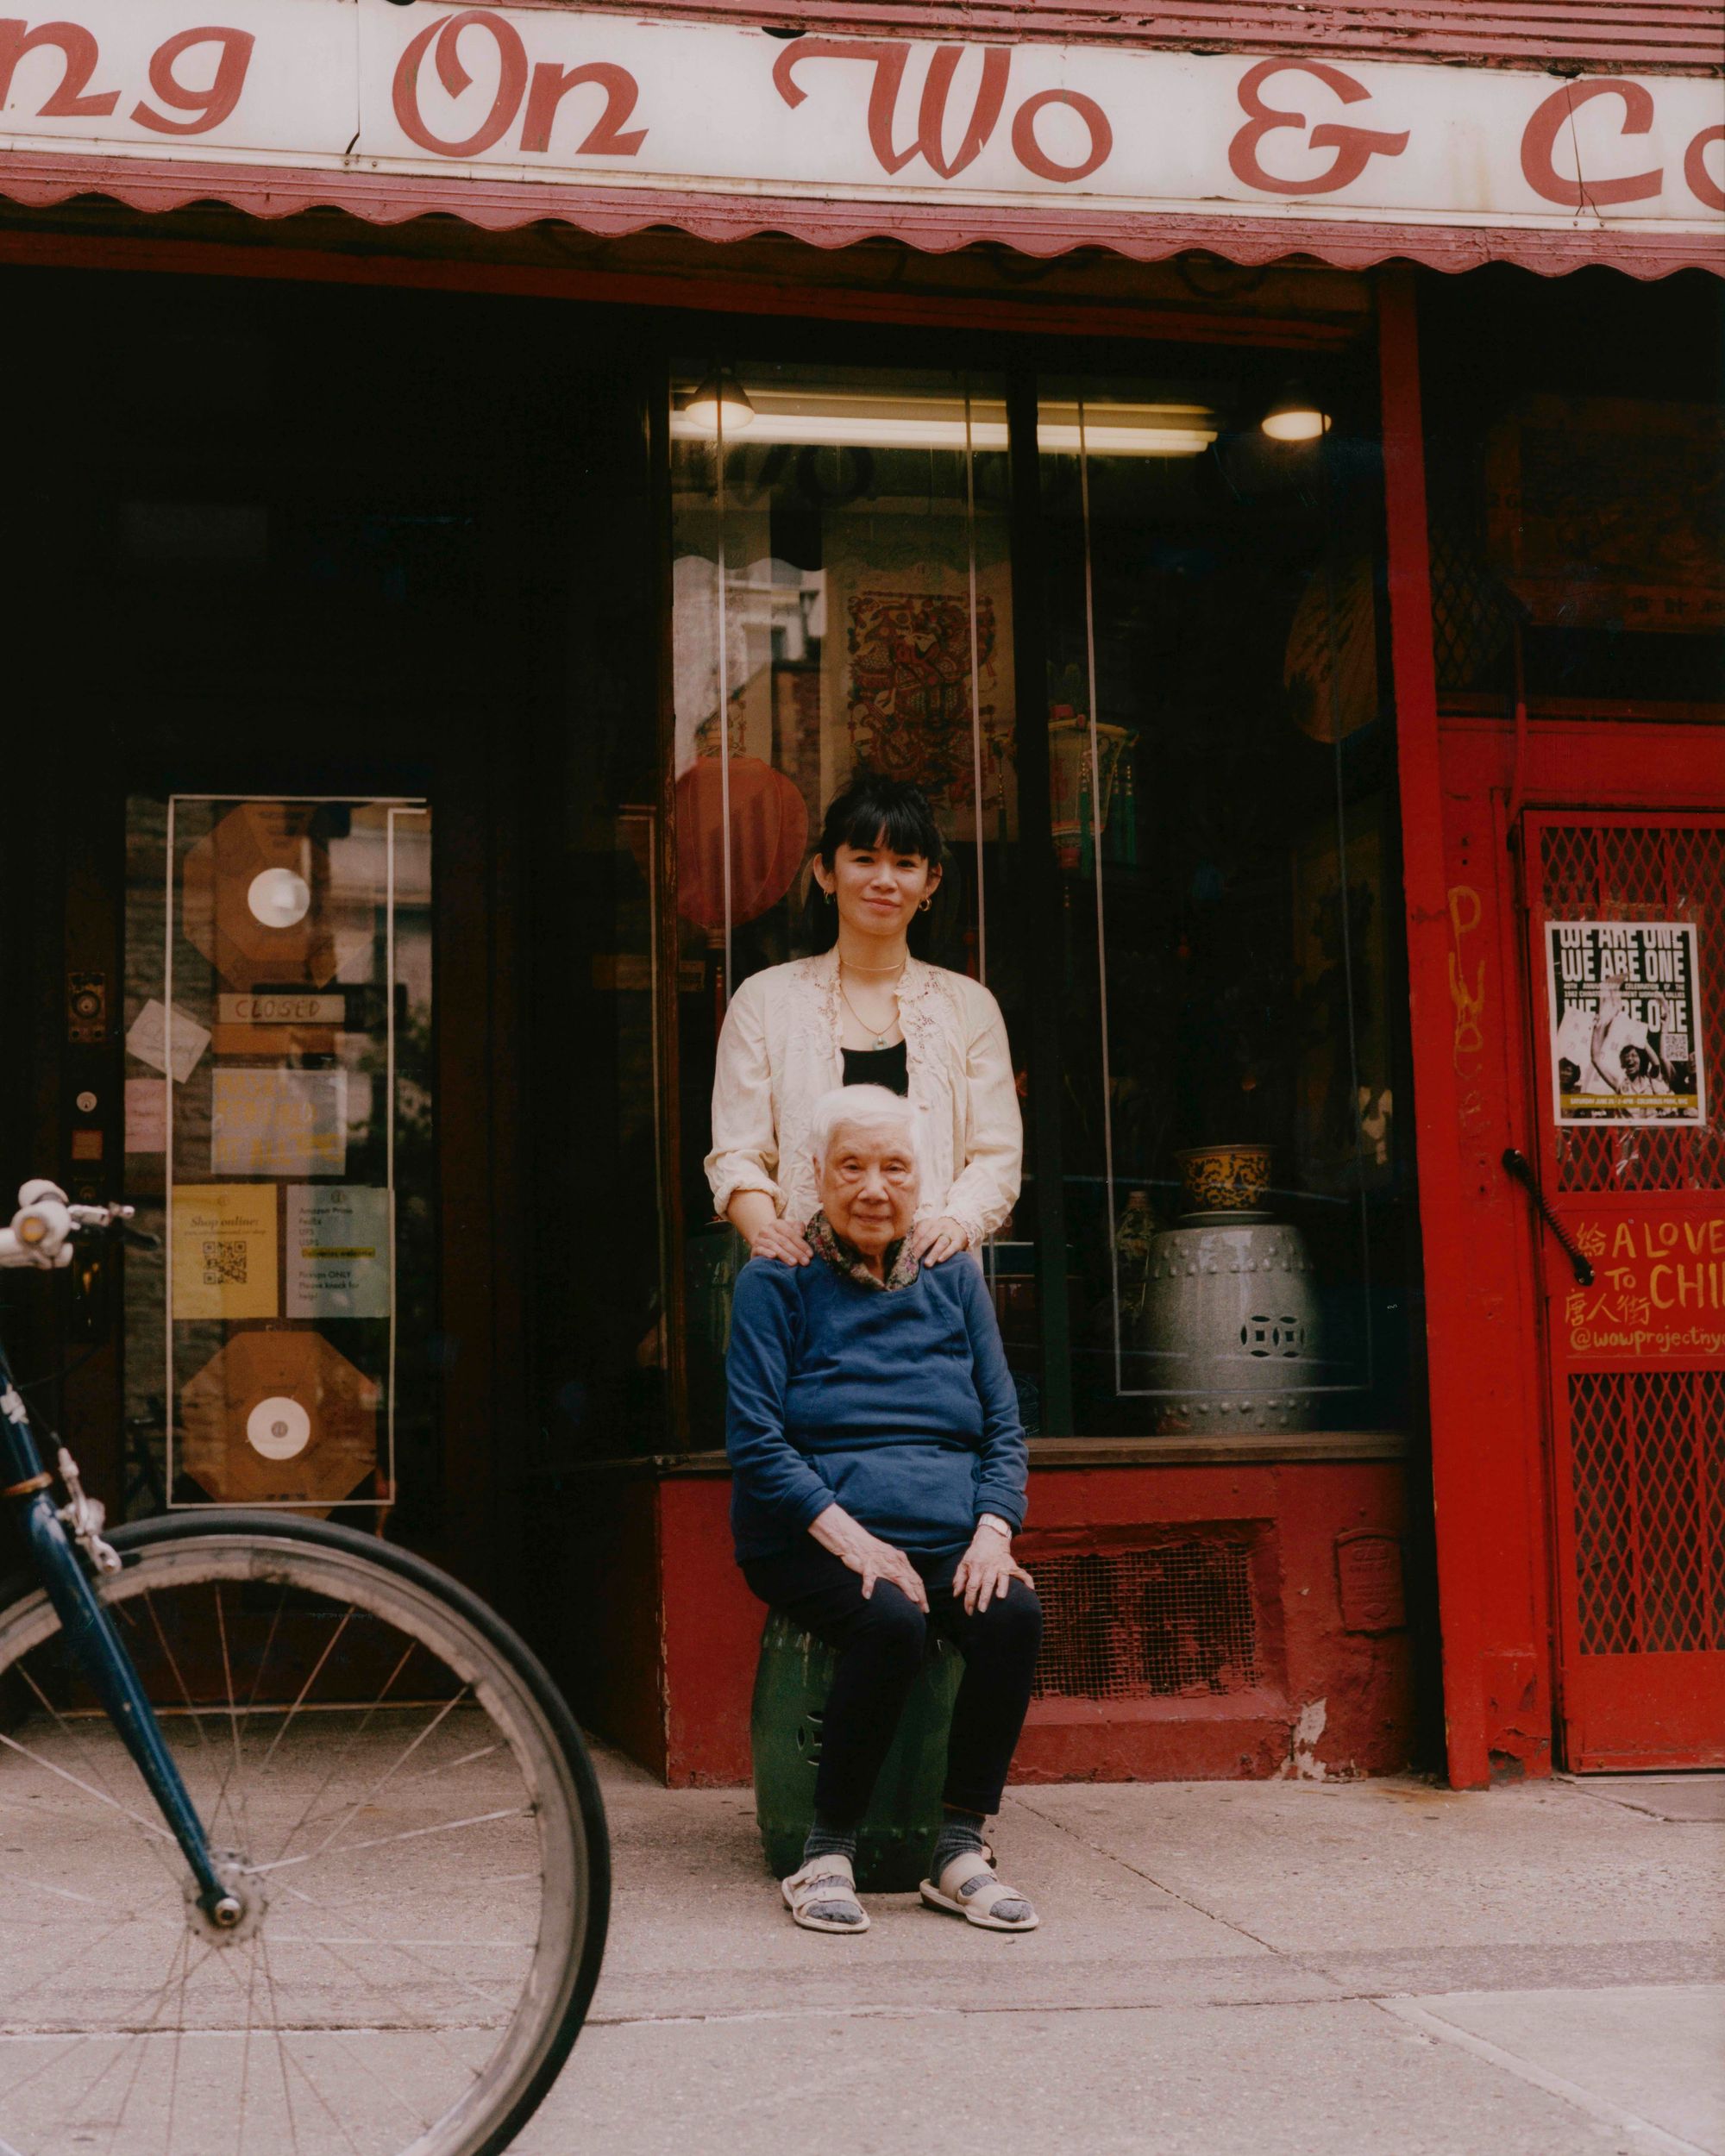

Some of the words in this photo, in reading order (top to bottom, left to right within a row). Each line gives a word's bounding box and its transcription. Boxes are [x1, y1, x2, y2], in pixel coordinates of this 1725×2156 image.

[392, 10, 649, 157] On
[773, 37, 1113, 183] Wo
[1228, 57, 1410, 195] &
[1559, 930, 1593, 949] WE
[1561, 949, 1596, 982] WE
[1601, 949, 1640, 982] ARE
[1645, 950, 1685, 982] ONE
[235, 1000, 321, 1018] CLOSED
[191, 1215, 219, 1231] Shop
[1611, 1222, 1637, 1258] A
[1644, 1219, 1725, 1258] LOVE
[1603, 1266, 1637, 1291] TO
[1649, 1262, 1725, 1310] CHI
